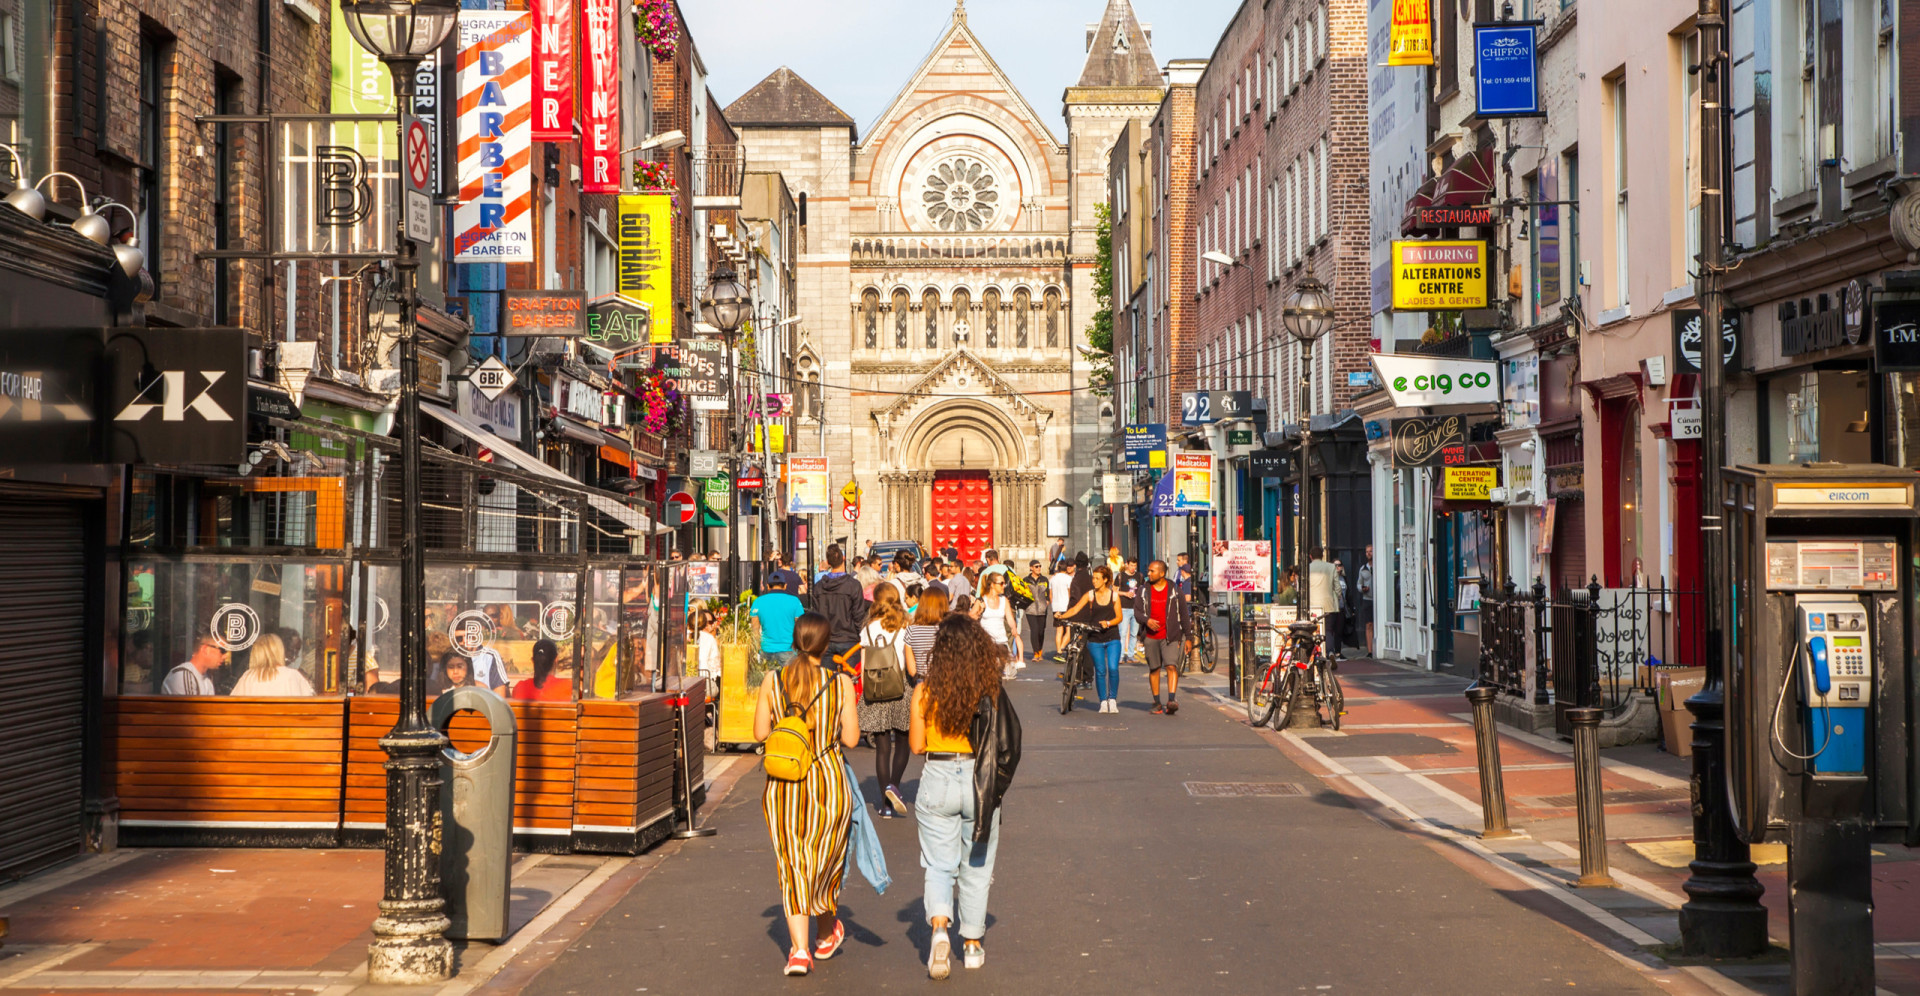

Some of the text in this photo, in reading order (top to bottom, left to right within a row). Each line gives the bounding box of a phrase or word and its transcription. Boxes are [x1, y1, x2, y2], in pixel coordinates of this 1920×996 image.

[470, 20, 527, 29] GRAFTON
[471, 34, 520, 43] BARBER
[1482, 47, 1529, 57] CHIFFON
[478, 51, 508, 229] BARBER
[317, 145, 373, 226] B
[471, 232, 527, 242] GRAFTON
[461, 232, 469, 255] THE
[473, 246, 521, 255] BARBER
[621, 213, 656, 291] GOTHAM
[1408, 249, 1473, 261] TAILORING
[1402, 268, 1481, 280] ALTERATIONS
[1419, 282, 1464, 294] CENTRE
[507, 297, 580, 311] GRAFTON
[1402, 297, 1481, 305] LADIES & GENTS
[512, 314, 575, 327] BARBER
[586, 310, 645, 342] EAT
[688, 341, 719, 351] WINES
[661, 342, 714, 376] KEHOES
[479, 372, 503, 385] GBK
[663, 368, 691, 377] SPIRITS
[1, 371, 42, 401] FOR HAIR
[665, 379, 716, 393] OUNGE
[1393, 371, 1490, 394] e cig co
[1184, 396, 1211, 421] 22
[1136, 426, 1147, 434] Let
[1684, 426, 1701, 435] 30
[1442, 446, 1464, 454] WINE
[1177, 459, 1209, 467] Meditation
[1444, 455, 1465, 464] BAR
[227, 613, 247, 641] B
[465, 619, 484, 648] B
